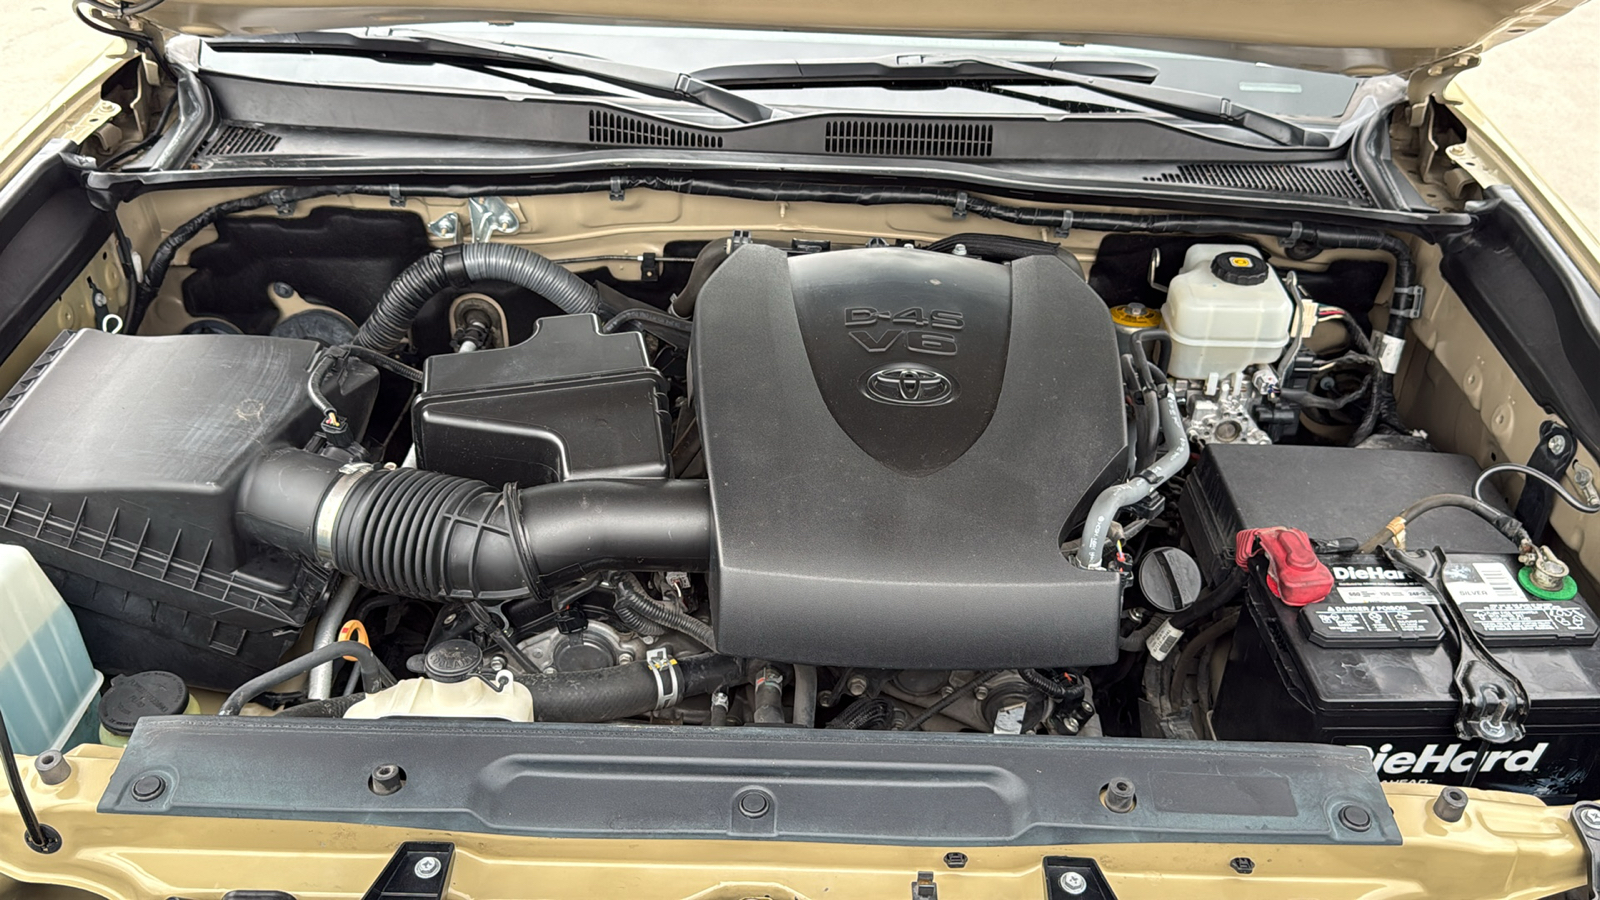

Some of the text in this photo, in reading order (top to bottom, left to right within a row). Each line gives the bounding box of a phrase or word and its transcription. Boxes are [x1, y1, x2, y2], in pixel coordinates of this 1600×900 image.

[844, 306, 965, 330] D-4S
[848, 329, 958, 356] V6
[1332, 566, 1407, 580] DieHar
[1347, 743, 1549, 775] ieHard
